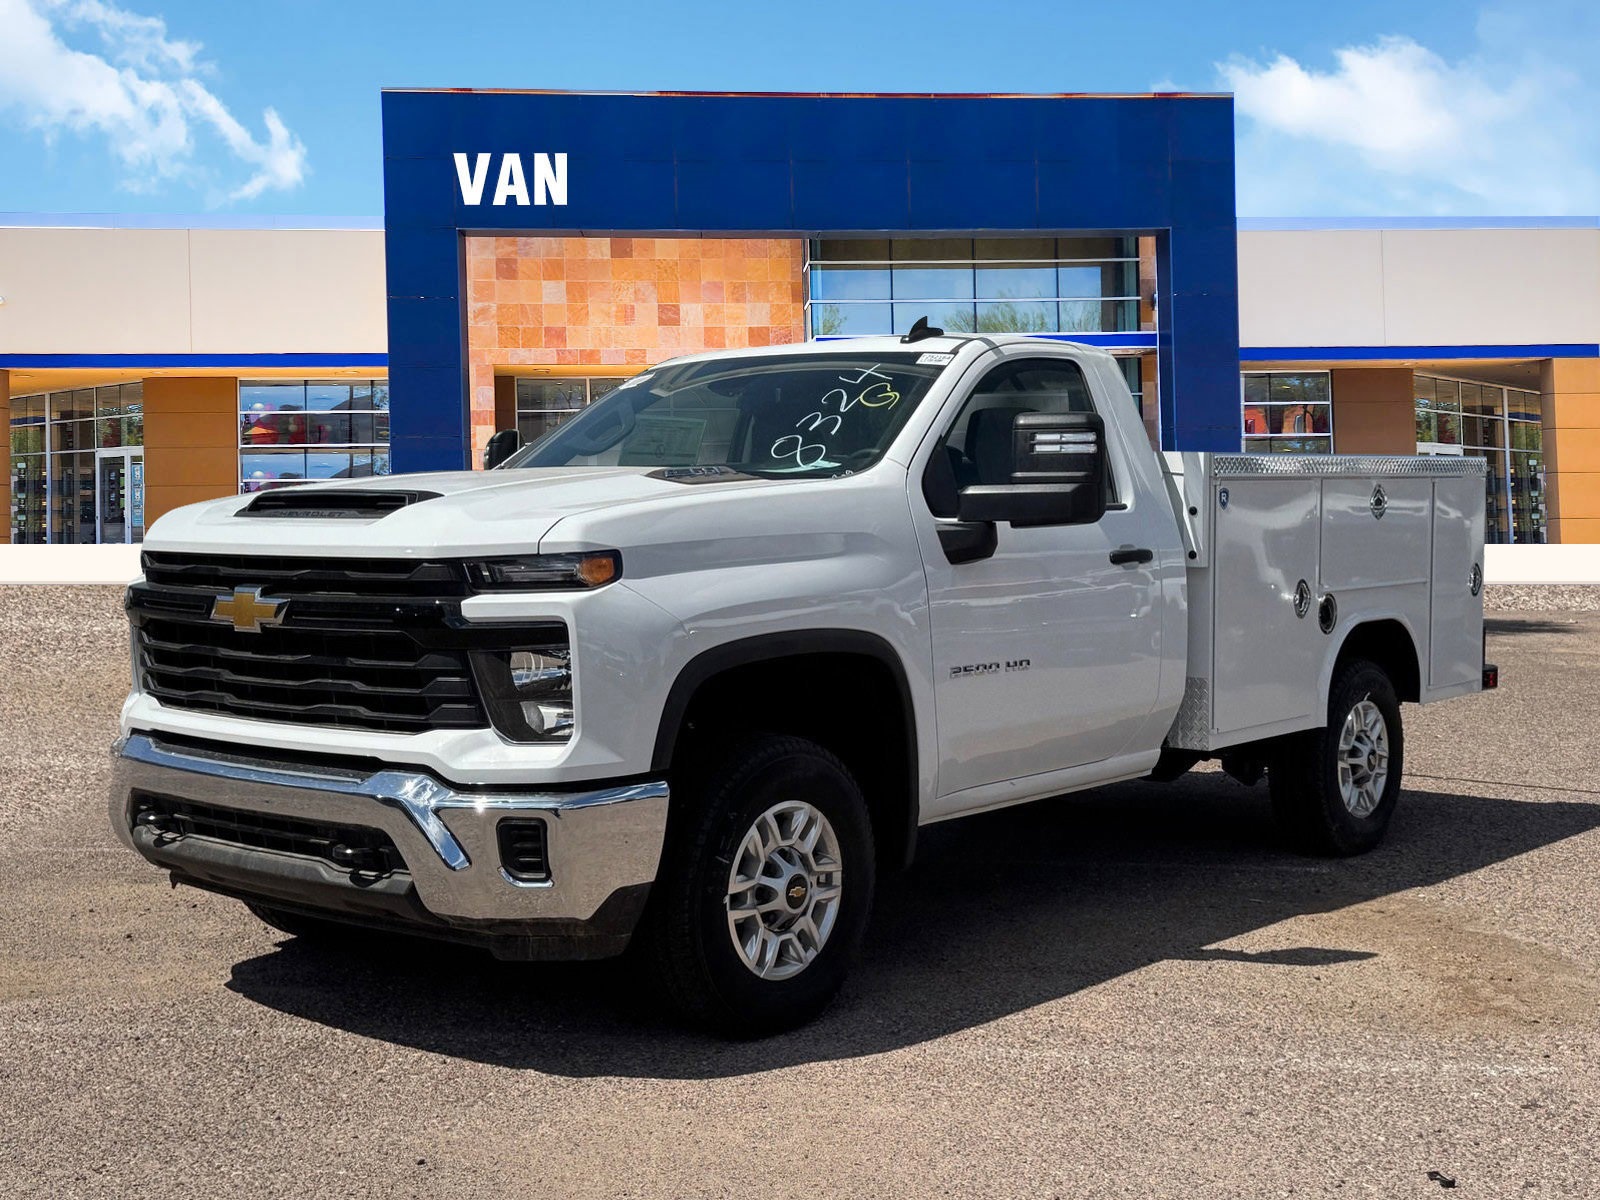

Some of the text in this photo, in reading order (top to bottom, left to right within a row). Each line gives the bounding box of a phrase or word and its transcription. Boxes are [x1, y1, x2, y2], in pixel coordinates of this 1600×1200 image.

[453, 152, 568, 206] VAN
[770, 363, 893, 468] 8324
[272, 510, 346, 518] CHEVROLET
[949, 659, 1031, 679] 2500 HD
